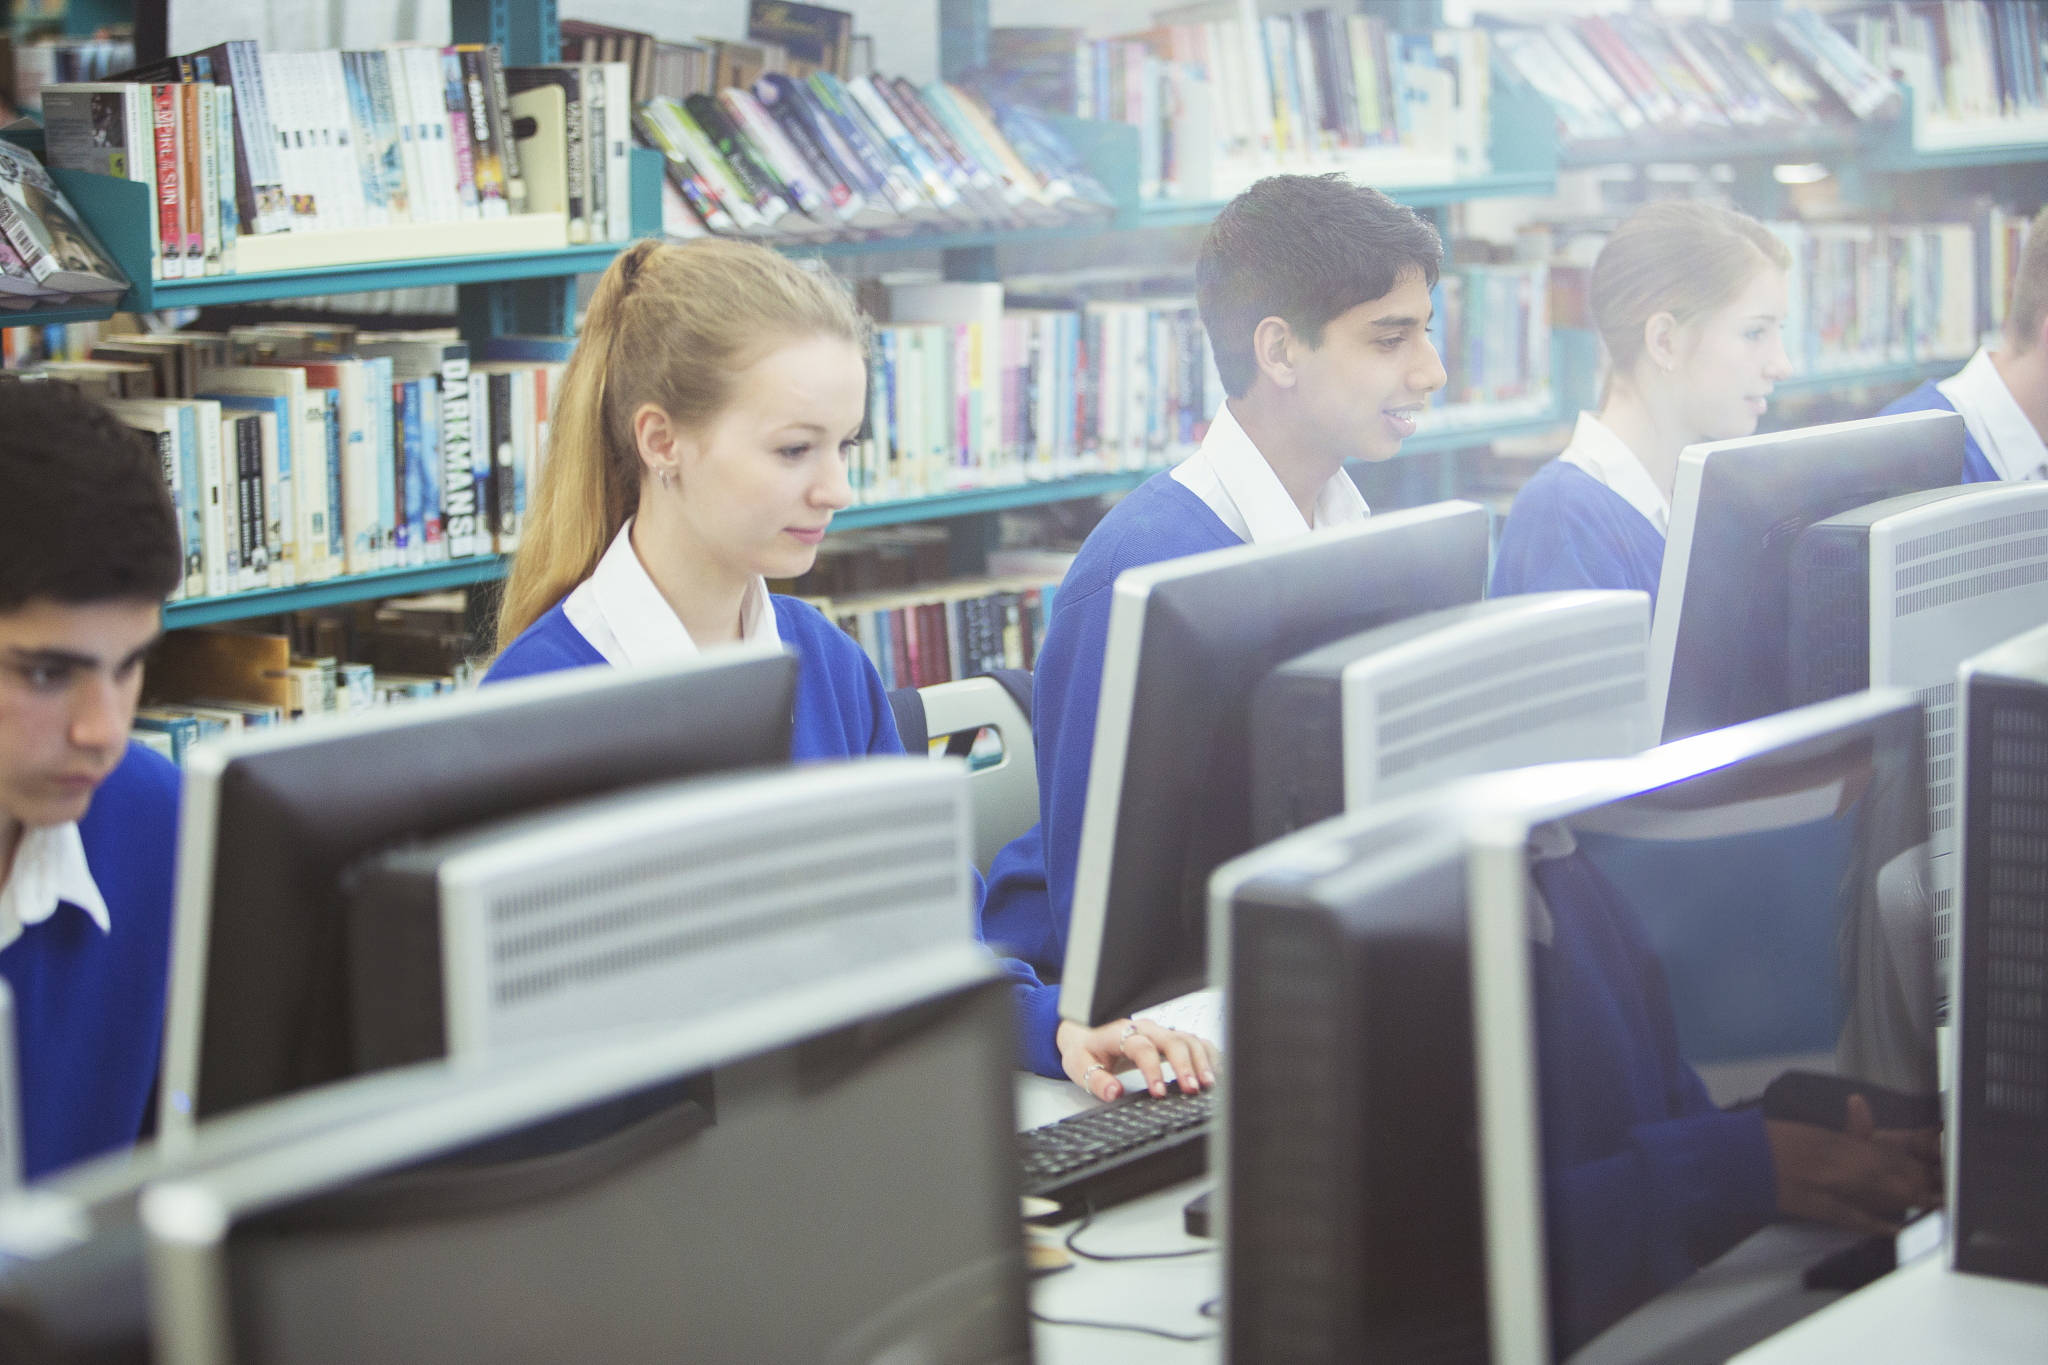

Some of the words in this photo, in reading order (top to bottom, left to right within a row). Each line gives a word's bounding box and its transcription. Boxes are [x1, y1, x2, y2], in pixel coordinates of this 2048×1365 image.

[159, 100, 173, 154] EMPIRE
[163, 173, 178, 205] SUN
[442, 357, 475, 540] DARKMANS
